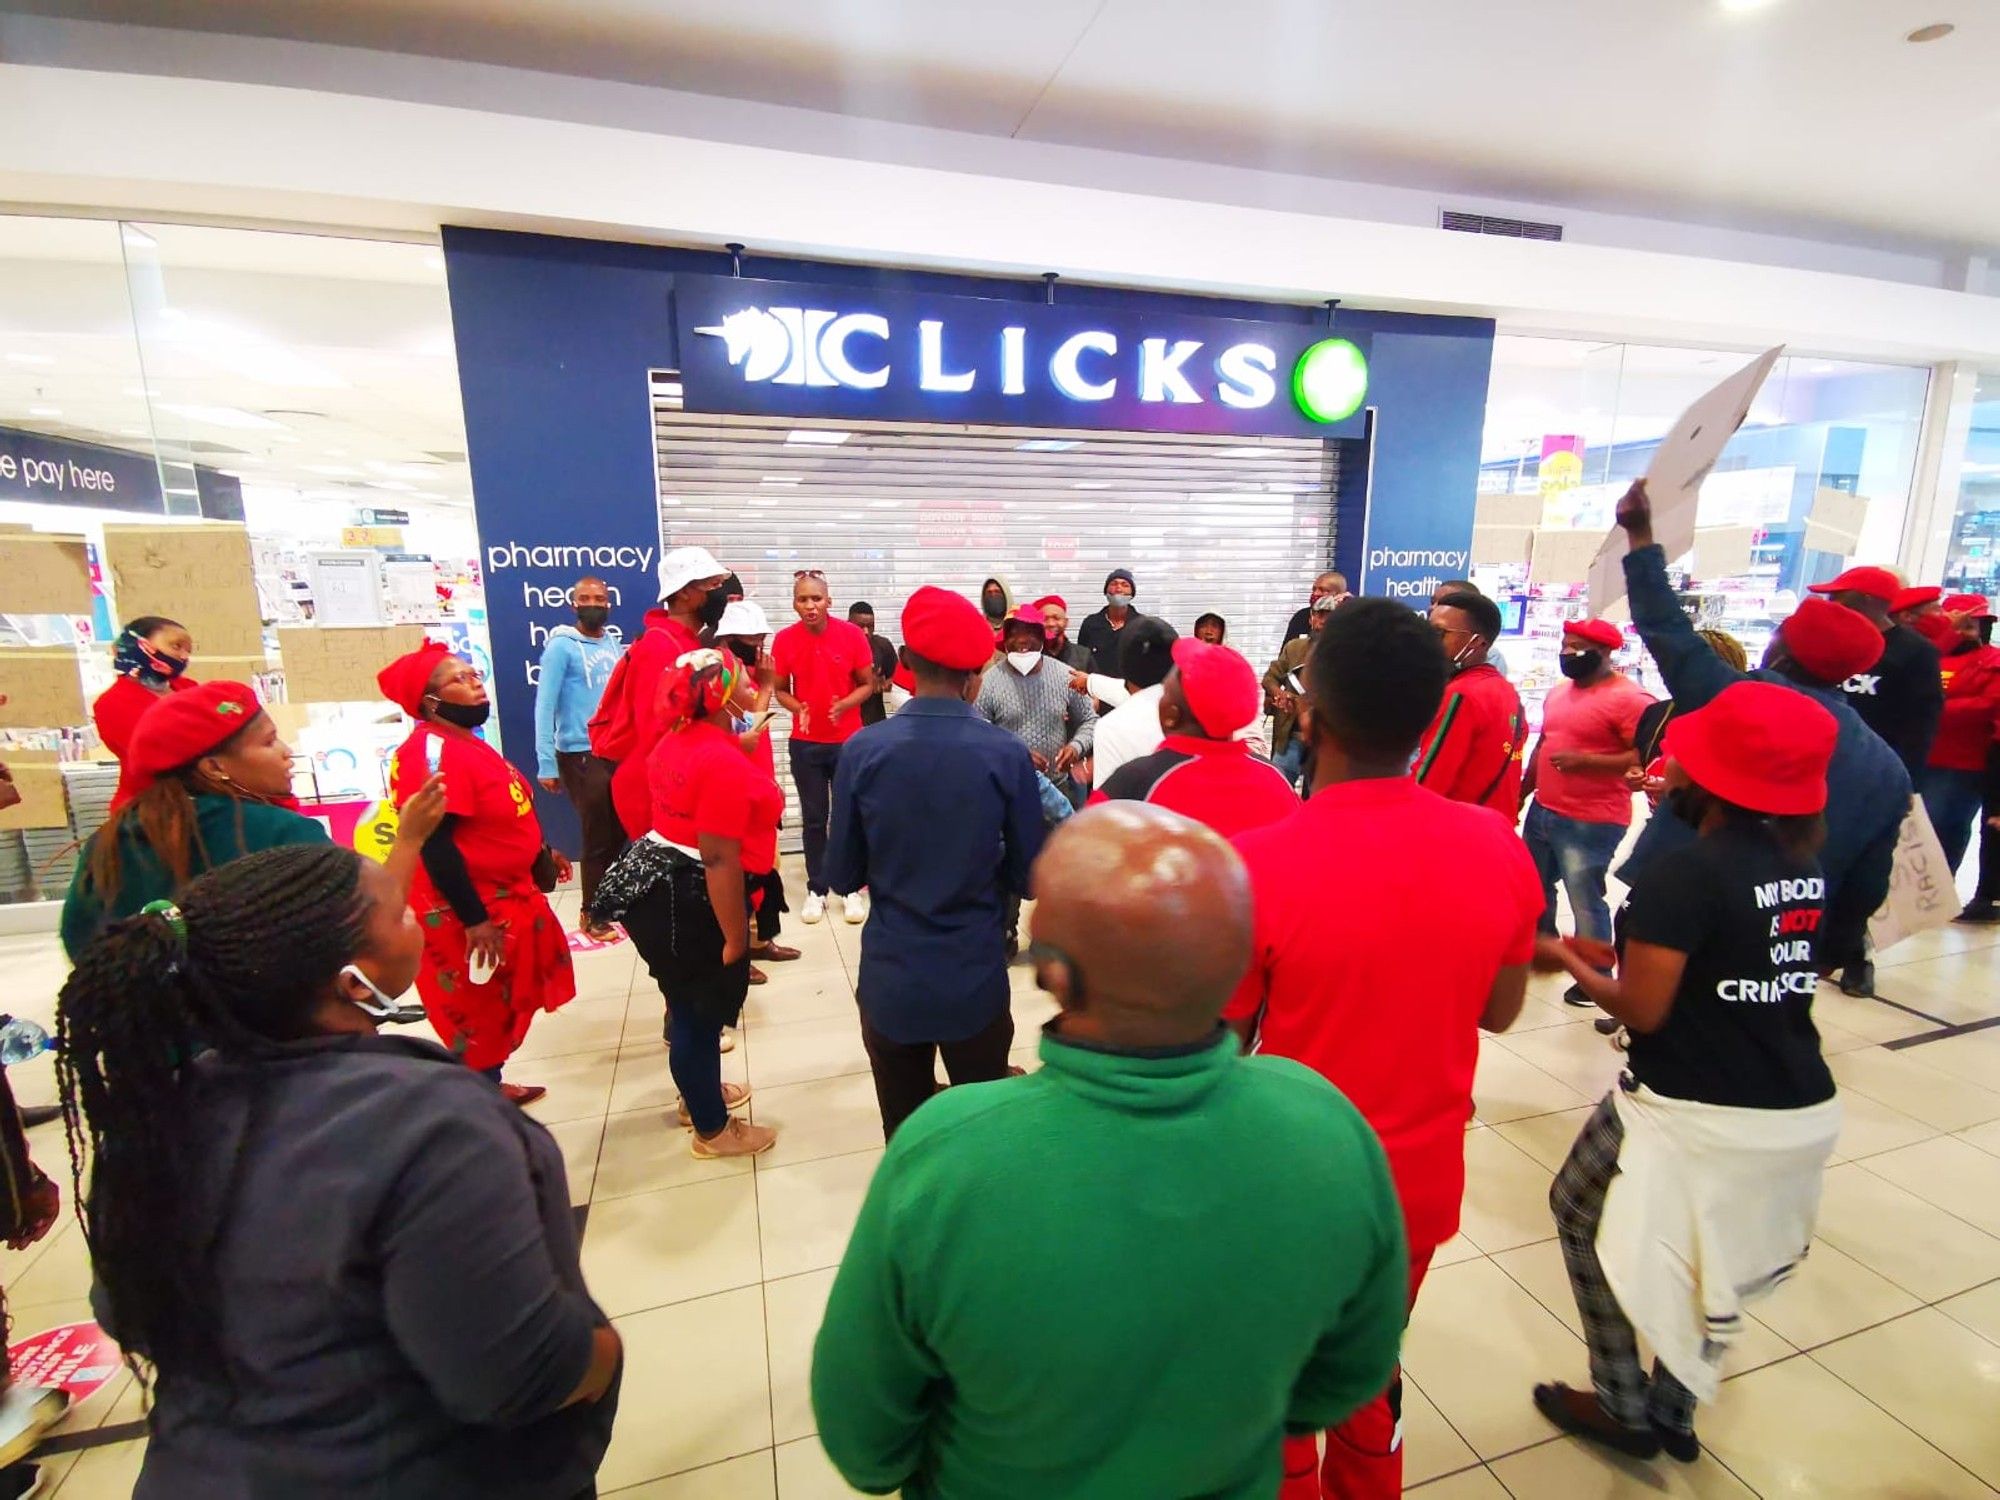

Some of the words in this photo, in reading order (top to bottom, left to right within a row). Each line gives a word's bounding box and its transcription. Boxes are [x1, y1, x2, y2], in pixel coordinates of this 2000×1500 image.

[819, 312, 1277, 409] CLICKS
[22, 457, 64, 491] pay
[69, 460, 115, 492] here
[488, 541, 653, 573] pharmacy
[1370, 546, 1467, 571] pharmacy
[1837, 673, 1882, 695] CK
[1754, 882, 1779, 909] MY
[1780, 877, 1825, 902] BOD
[1780, 908, 1824, 935] NOT
